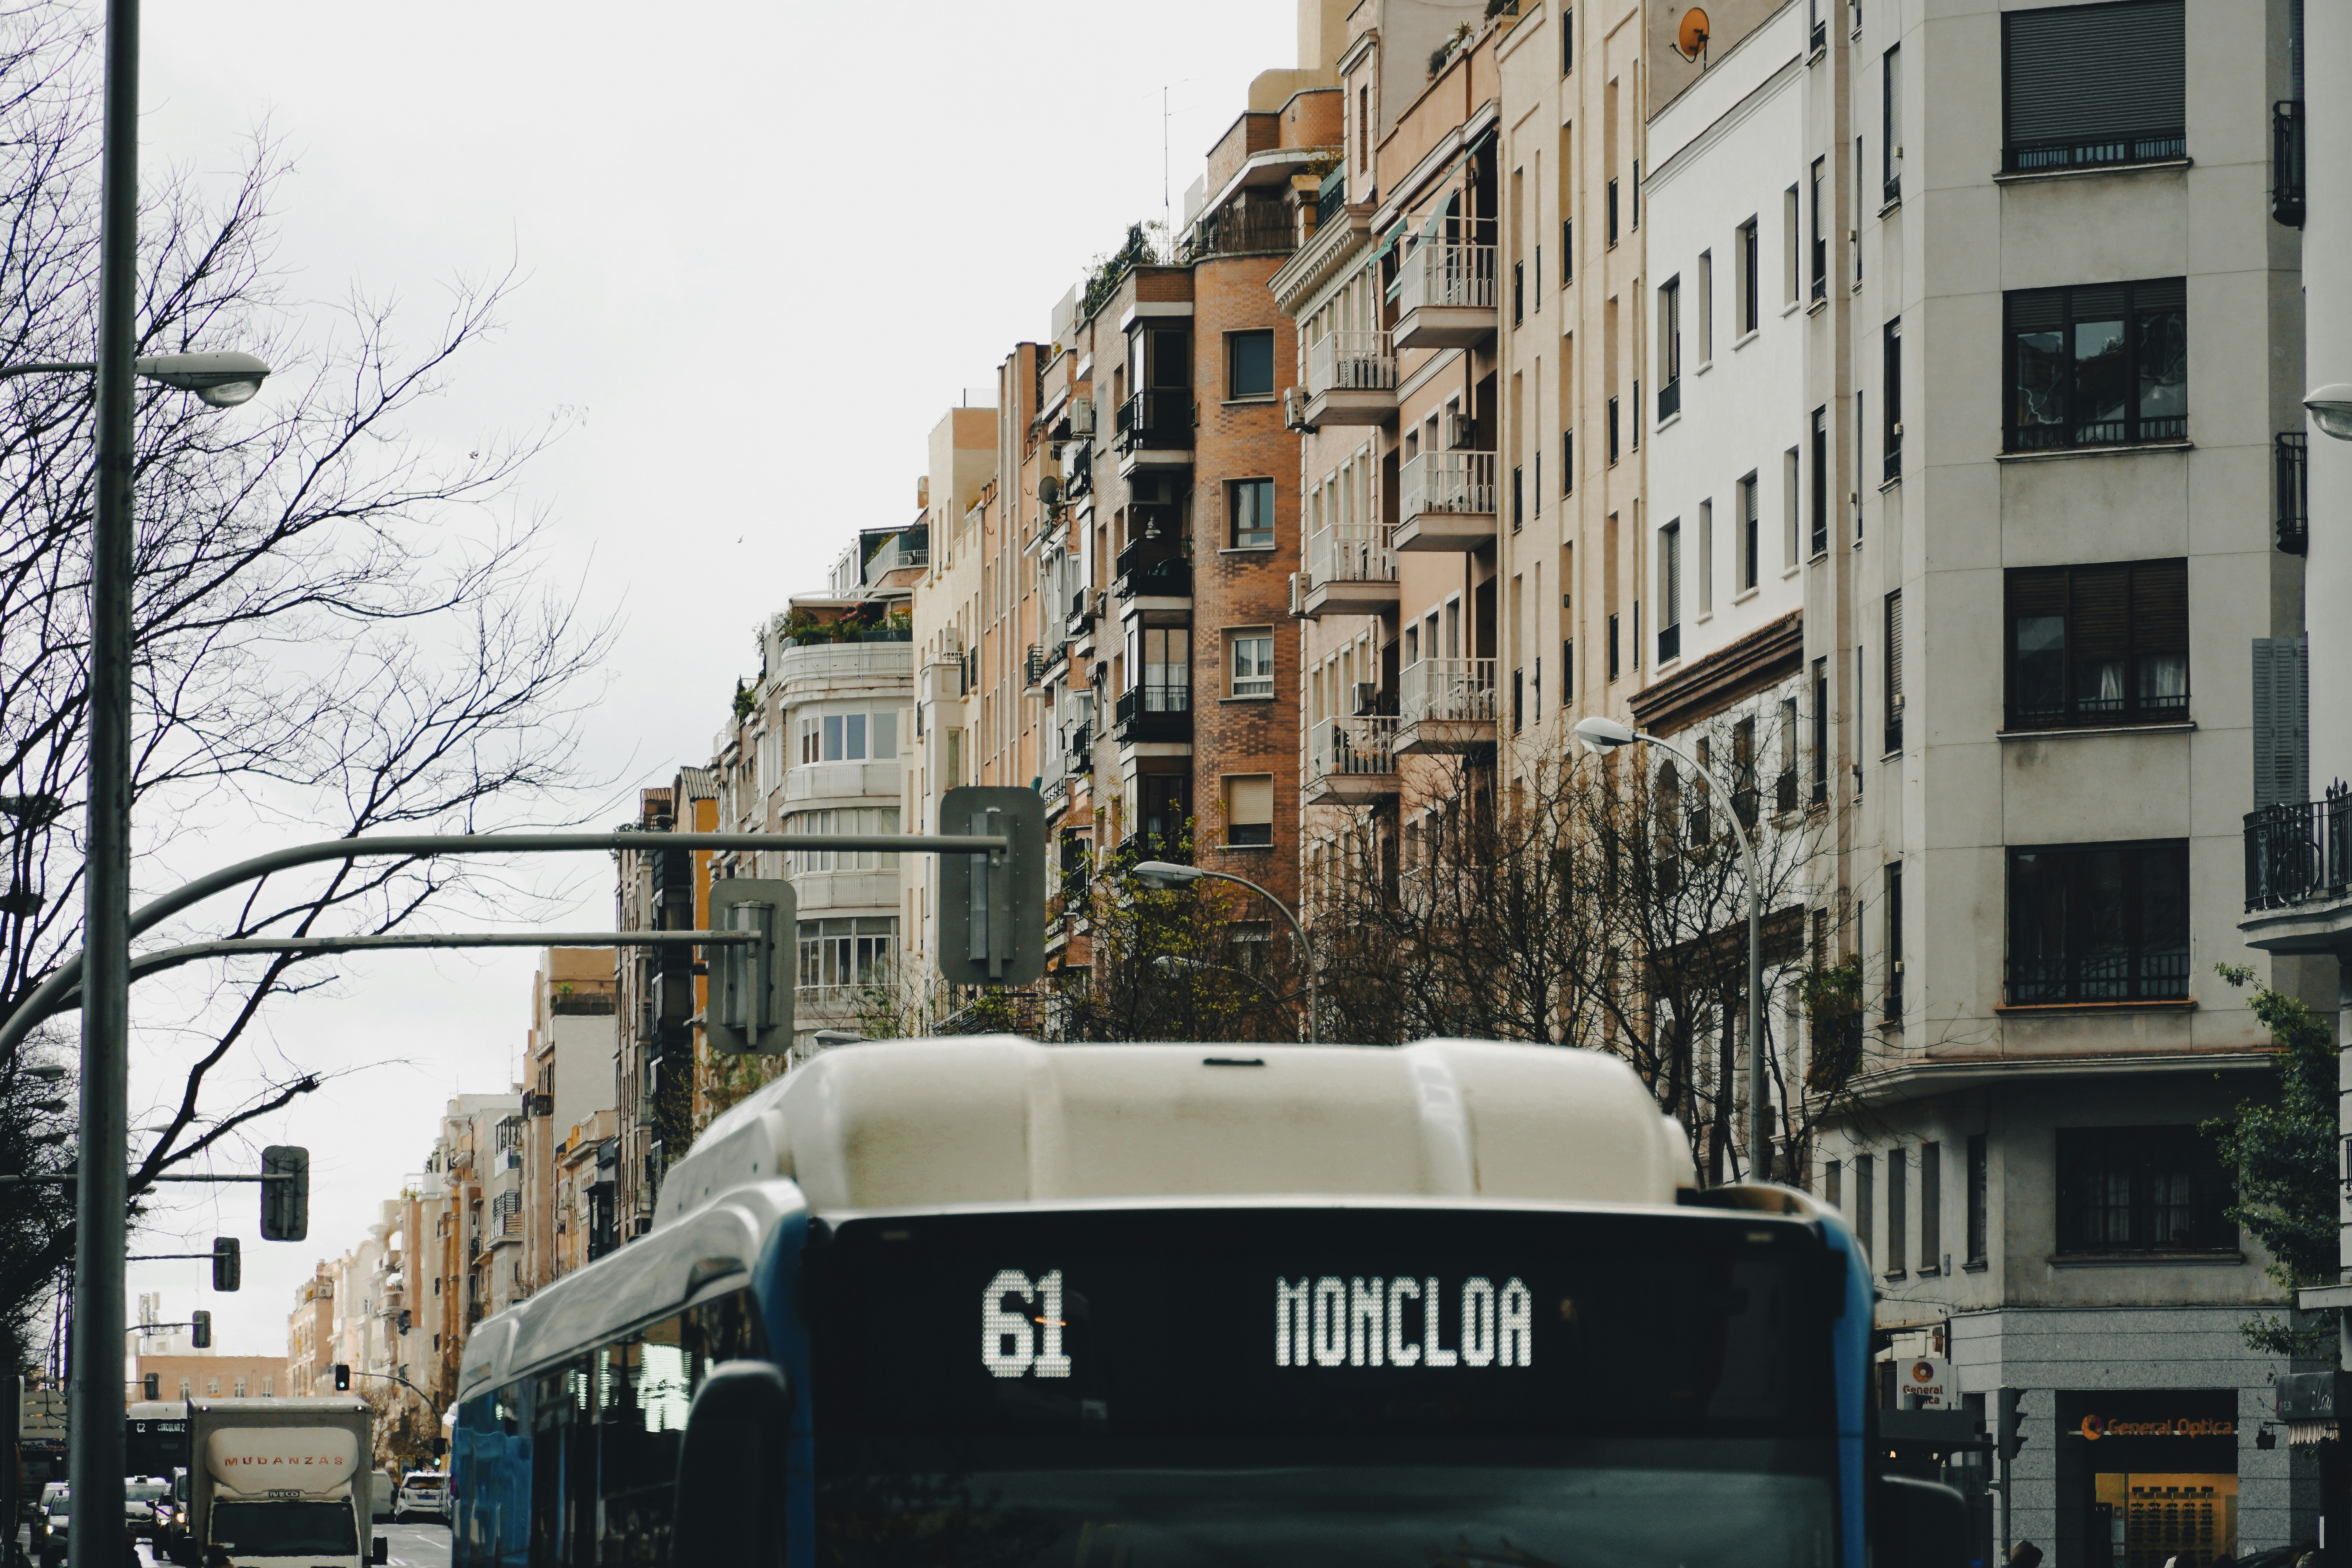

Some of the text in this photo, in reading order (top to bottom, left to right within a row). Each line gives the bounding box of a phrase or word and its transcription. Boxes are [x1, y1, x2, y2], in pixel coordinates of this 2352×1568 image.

[982, 1269, 1531, 1377] 61 MONCLOA
[1903, 1385, 1943, 1394] General
[137, 1423, 145, 1432] C2
[2108, 1418, 2232, 1439] General Optica
[224, 1456, 343, 1466] MUDANZAS
